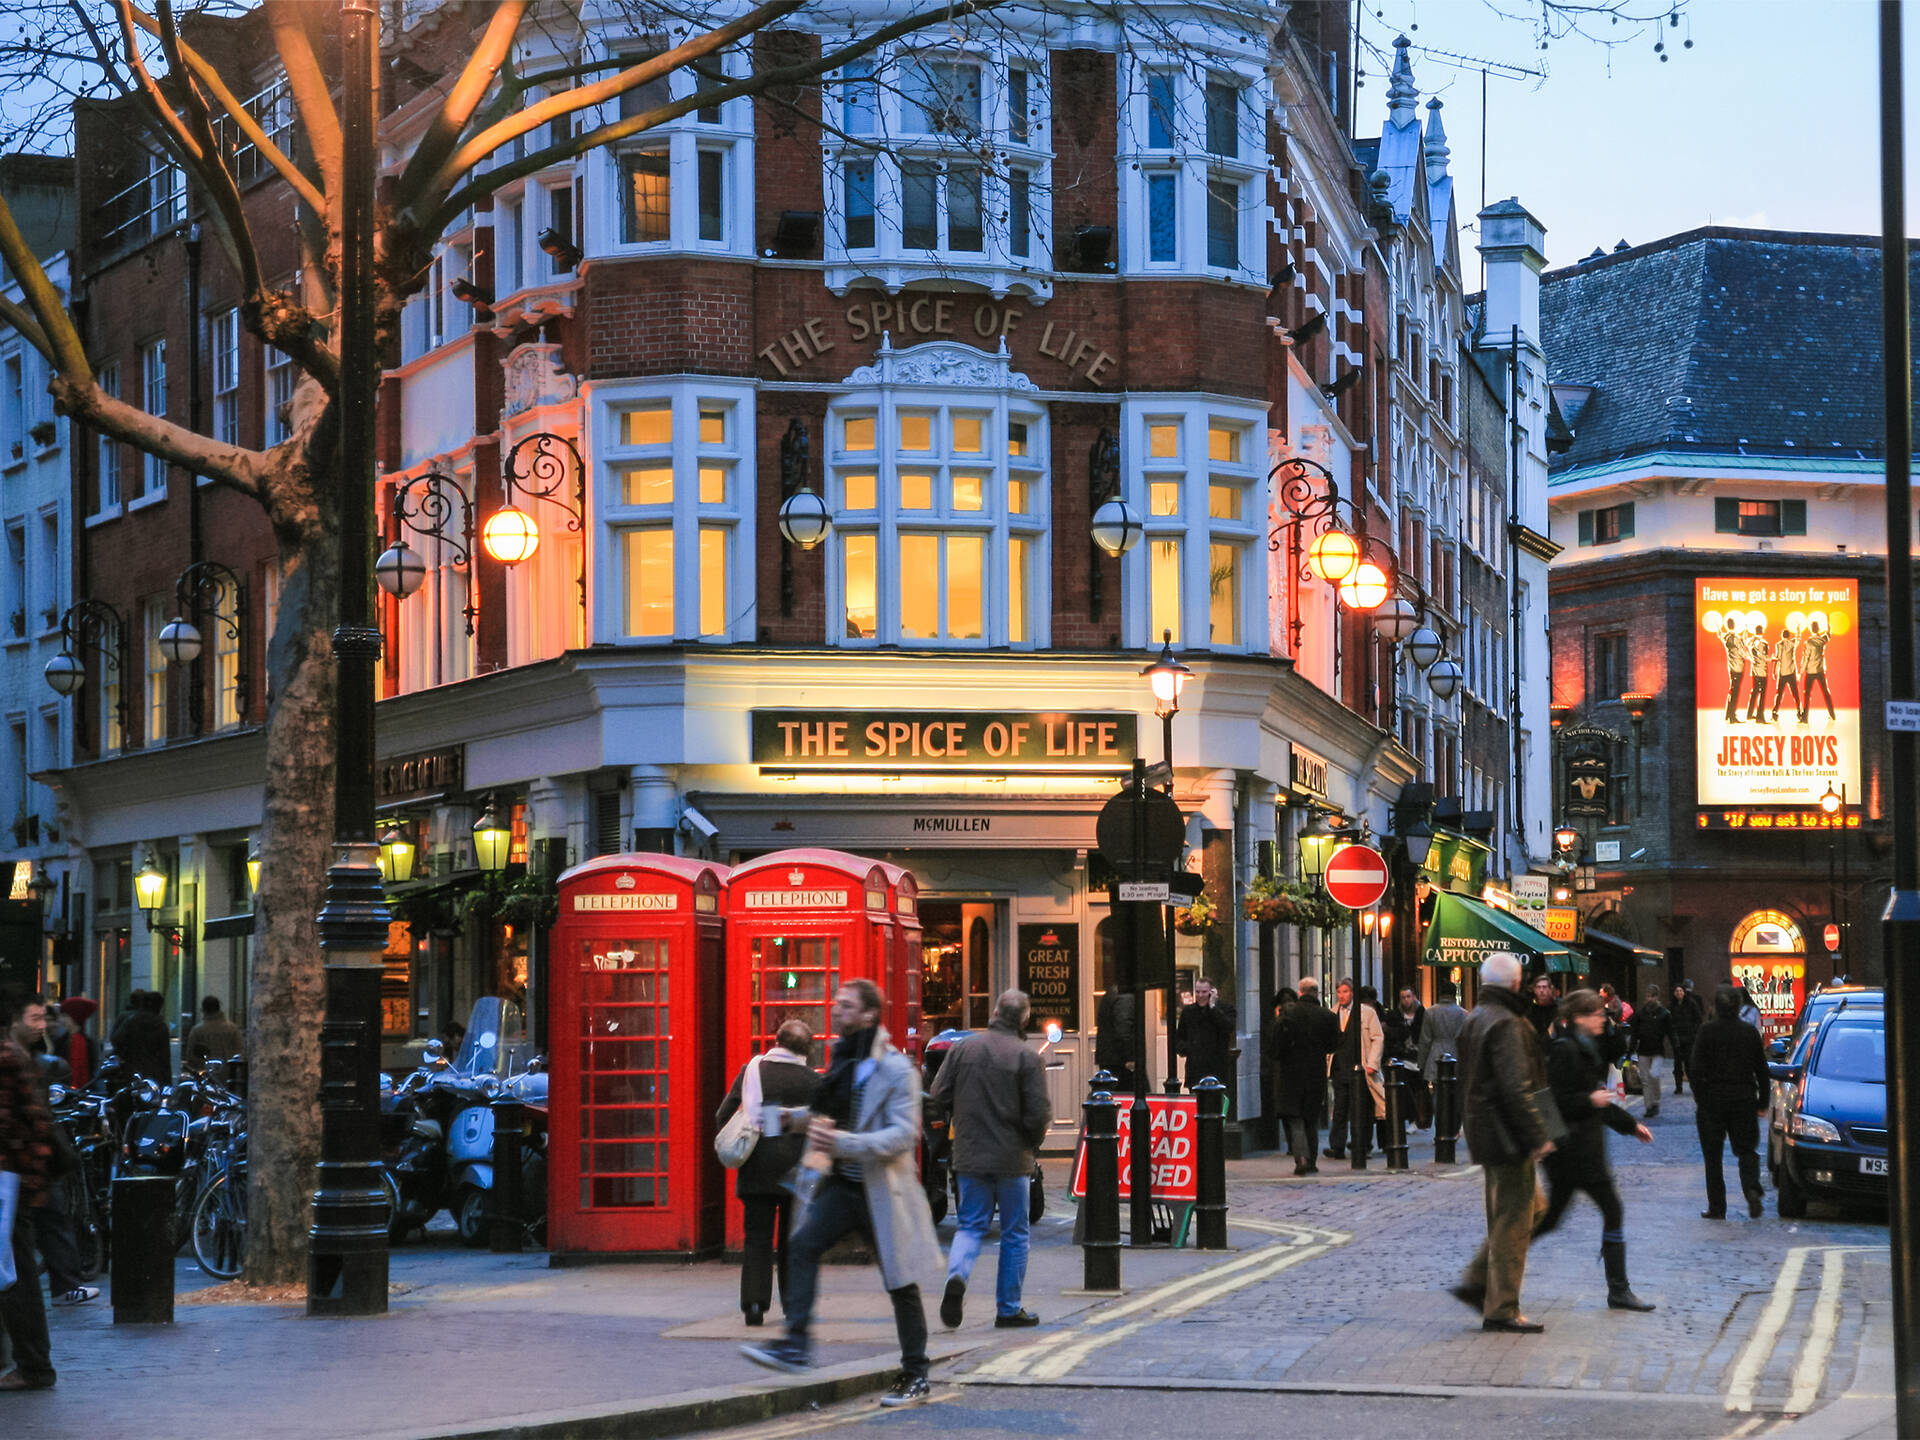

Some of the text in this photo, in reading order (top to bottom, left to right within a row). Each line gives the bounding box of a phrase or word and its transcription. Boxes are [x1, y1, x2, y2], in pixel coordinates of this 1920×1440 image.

[757, 299, 1118, 386] THE SPICE OF LIFE
[1703, 587, 1850, 604] Have we got a story for you!
[1890, 706, 1903, 714] No
[777, 721, 1120, 757] THE SPICE OF LIFE
[1717, 735, 1838, 767] JERSEY BOYS
[1728, 769, 1743, 778] Story
[1816, 769, 1838, 777] Seasons
[1749, 815, 1773, 828] you
[1801, 812, 1817, 827] to
[750, 892, 843, 906] TELEPHONE
[1515, 890, 1546, 898] Original
[580, 895, 673, 909] TELEPHONE
[1440, 937, 1510, 950] RISTORANTE
[1028, 949, 1070, 963] GREAT
[1426, 948, 1530, 966] CAPPUCCO
[1028, 965, 1070, 979] FRESH
[1031, 982, 1067, 995] FOOD
[1773, 993, 1795, 1009] BOYS
[1117, 1109, 1188, 1132] RAD
